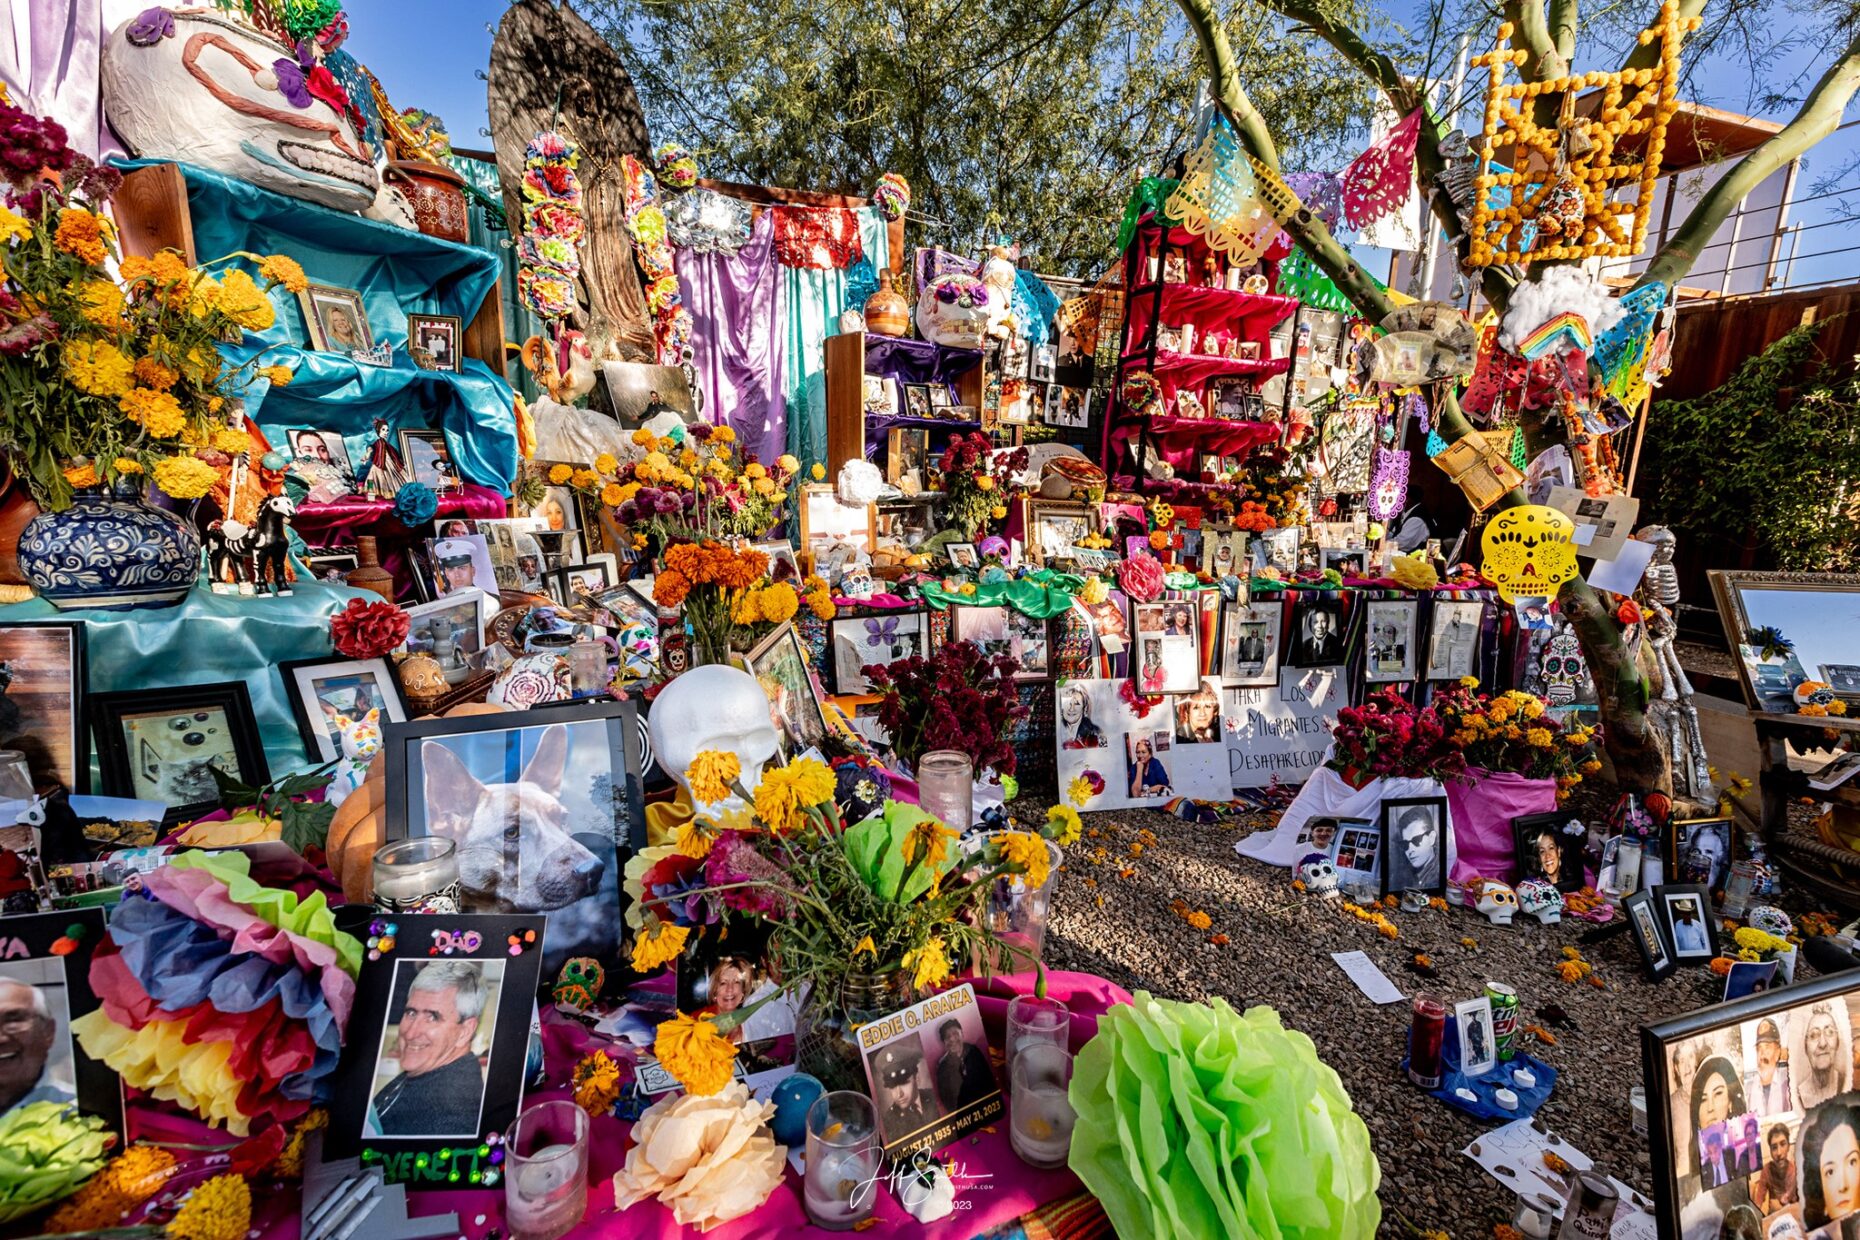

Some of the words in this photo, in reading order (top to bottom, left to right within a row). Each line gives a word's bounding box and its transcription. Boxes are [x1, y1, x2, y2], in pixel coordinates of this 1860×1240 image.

[1247, 710, 1320, 737] MIGRANTES
[861, 1017, 905, 1048] EDDIE
[905, 1010, 921, 1029] O.
[923, 987, 973, 1022] ARAIZA
[891, 1140, 922, 1163] AUGUST
[934, 1125, 952, 1142] 1935
[956, 1116, 973, 1131] MAY
[983, 1101, 1001, 1117] 2023
